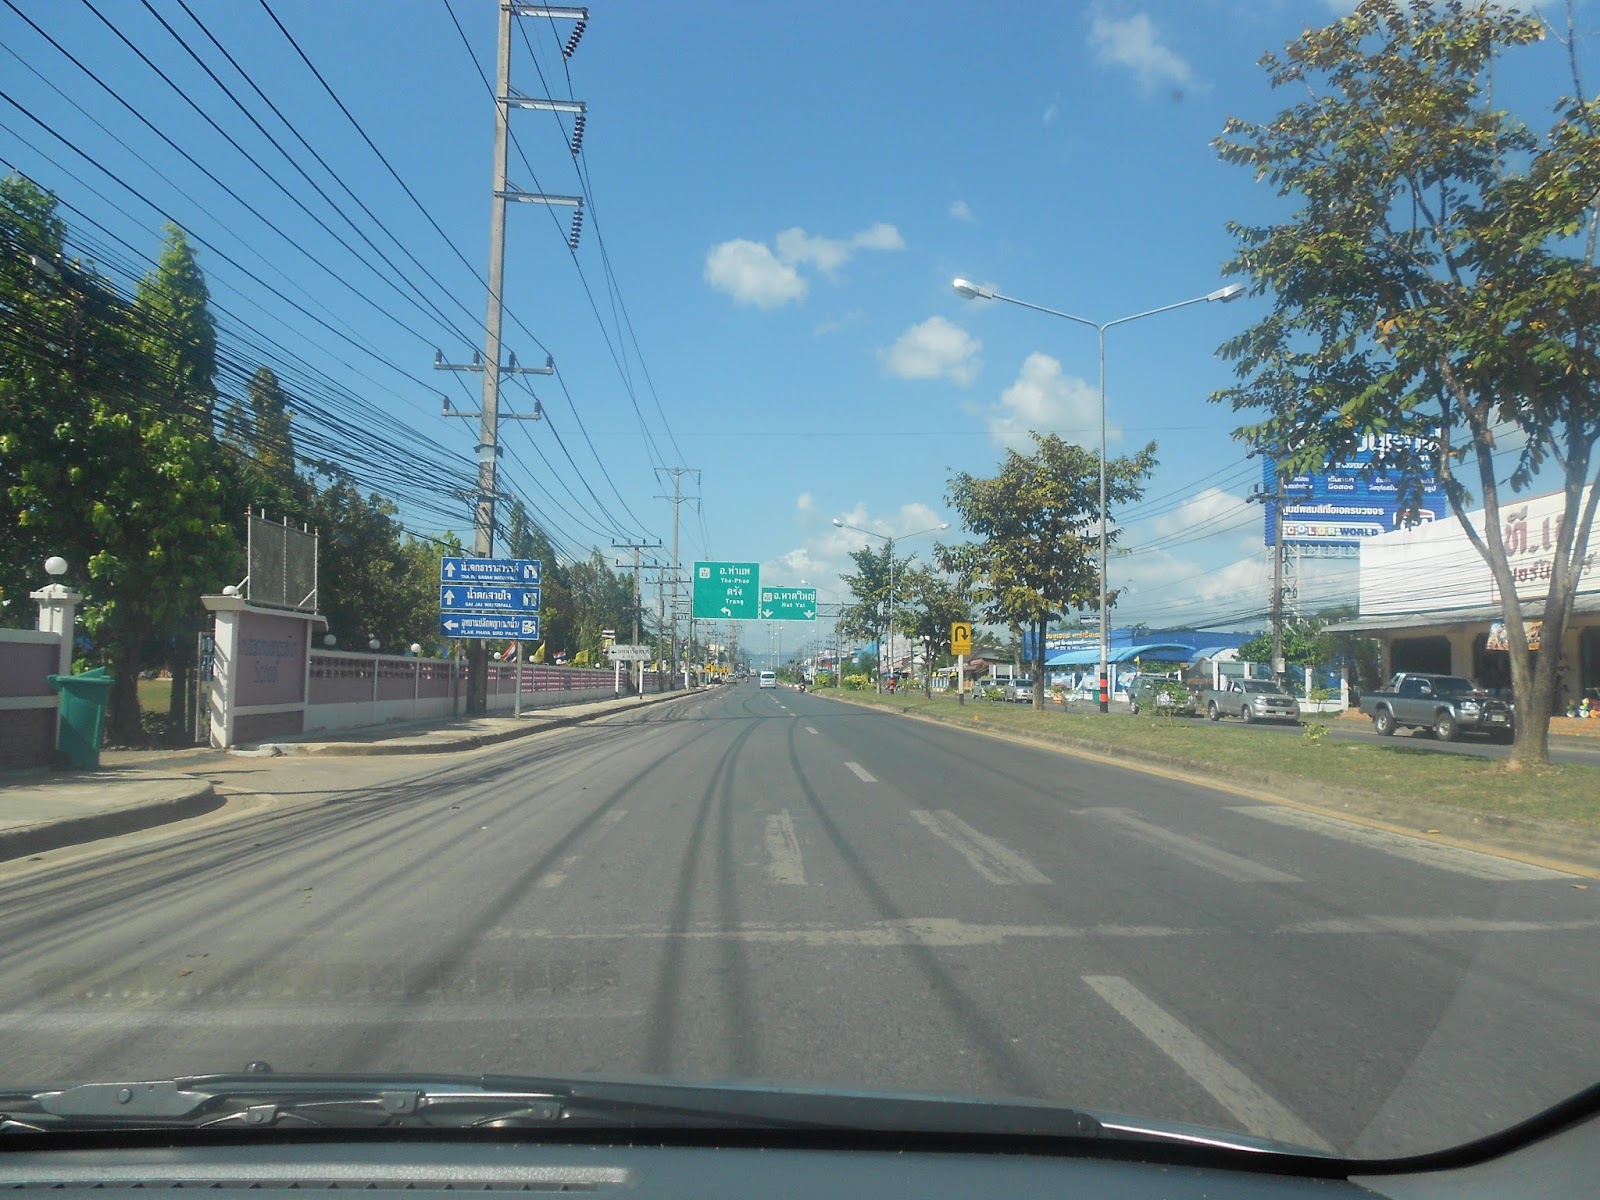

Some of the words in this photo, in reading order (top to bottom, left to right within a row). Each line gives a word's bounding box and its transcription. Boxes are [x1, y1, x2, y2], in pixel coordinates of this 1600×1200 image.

[1287, 524, 1337, 537] COLOR
[1340, 527, 1379, 537] WORLD
[727, 586, 742, 596] ตรัง
